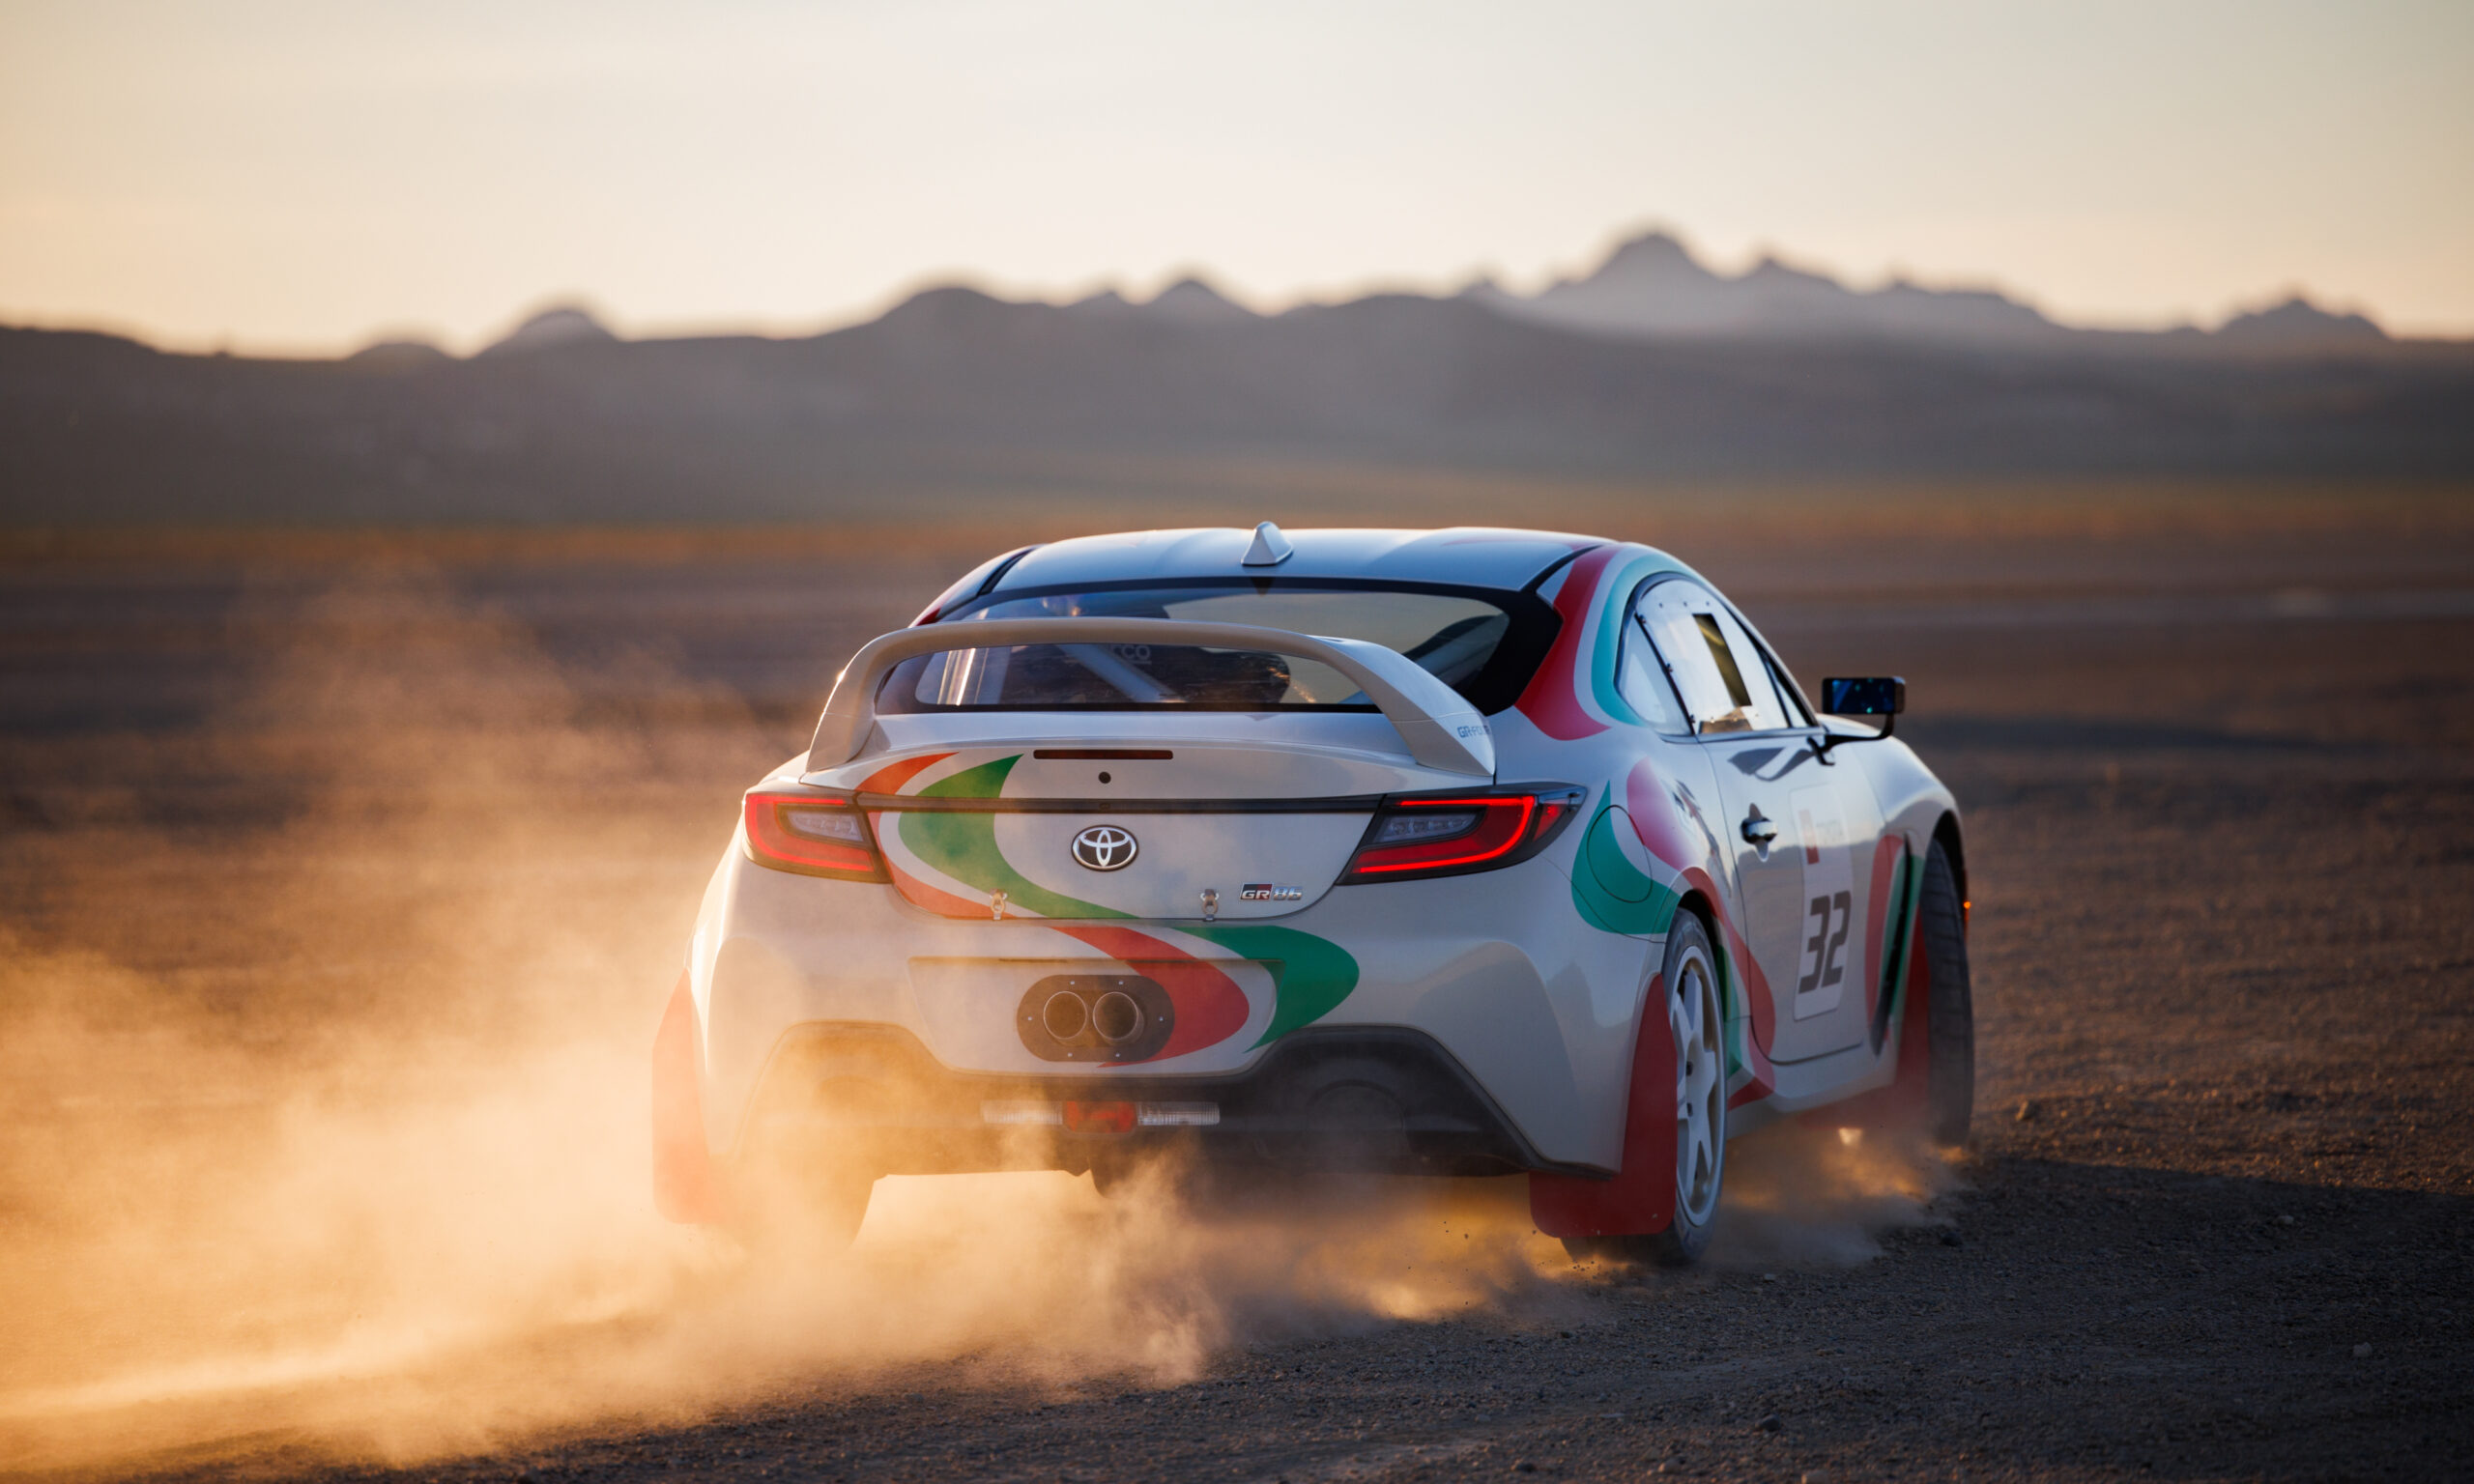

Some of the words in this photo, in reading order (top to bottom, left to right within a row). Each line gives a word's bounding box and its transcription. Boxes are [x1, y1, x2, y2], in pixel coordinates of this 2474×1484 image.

[1241, 890, 1271, 900] GR
[1273, 886, 1303, 900] 86
[1798, 890, 1852, 994] 32
